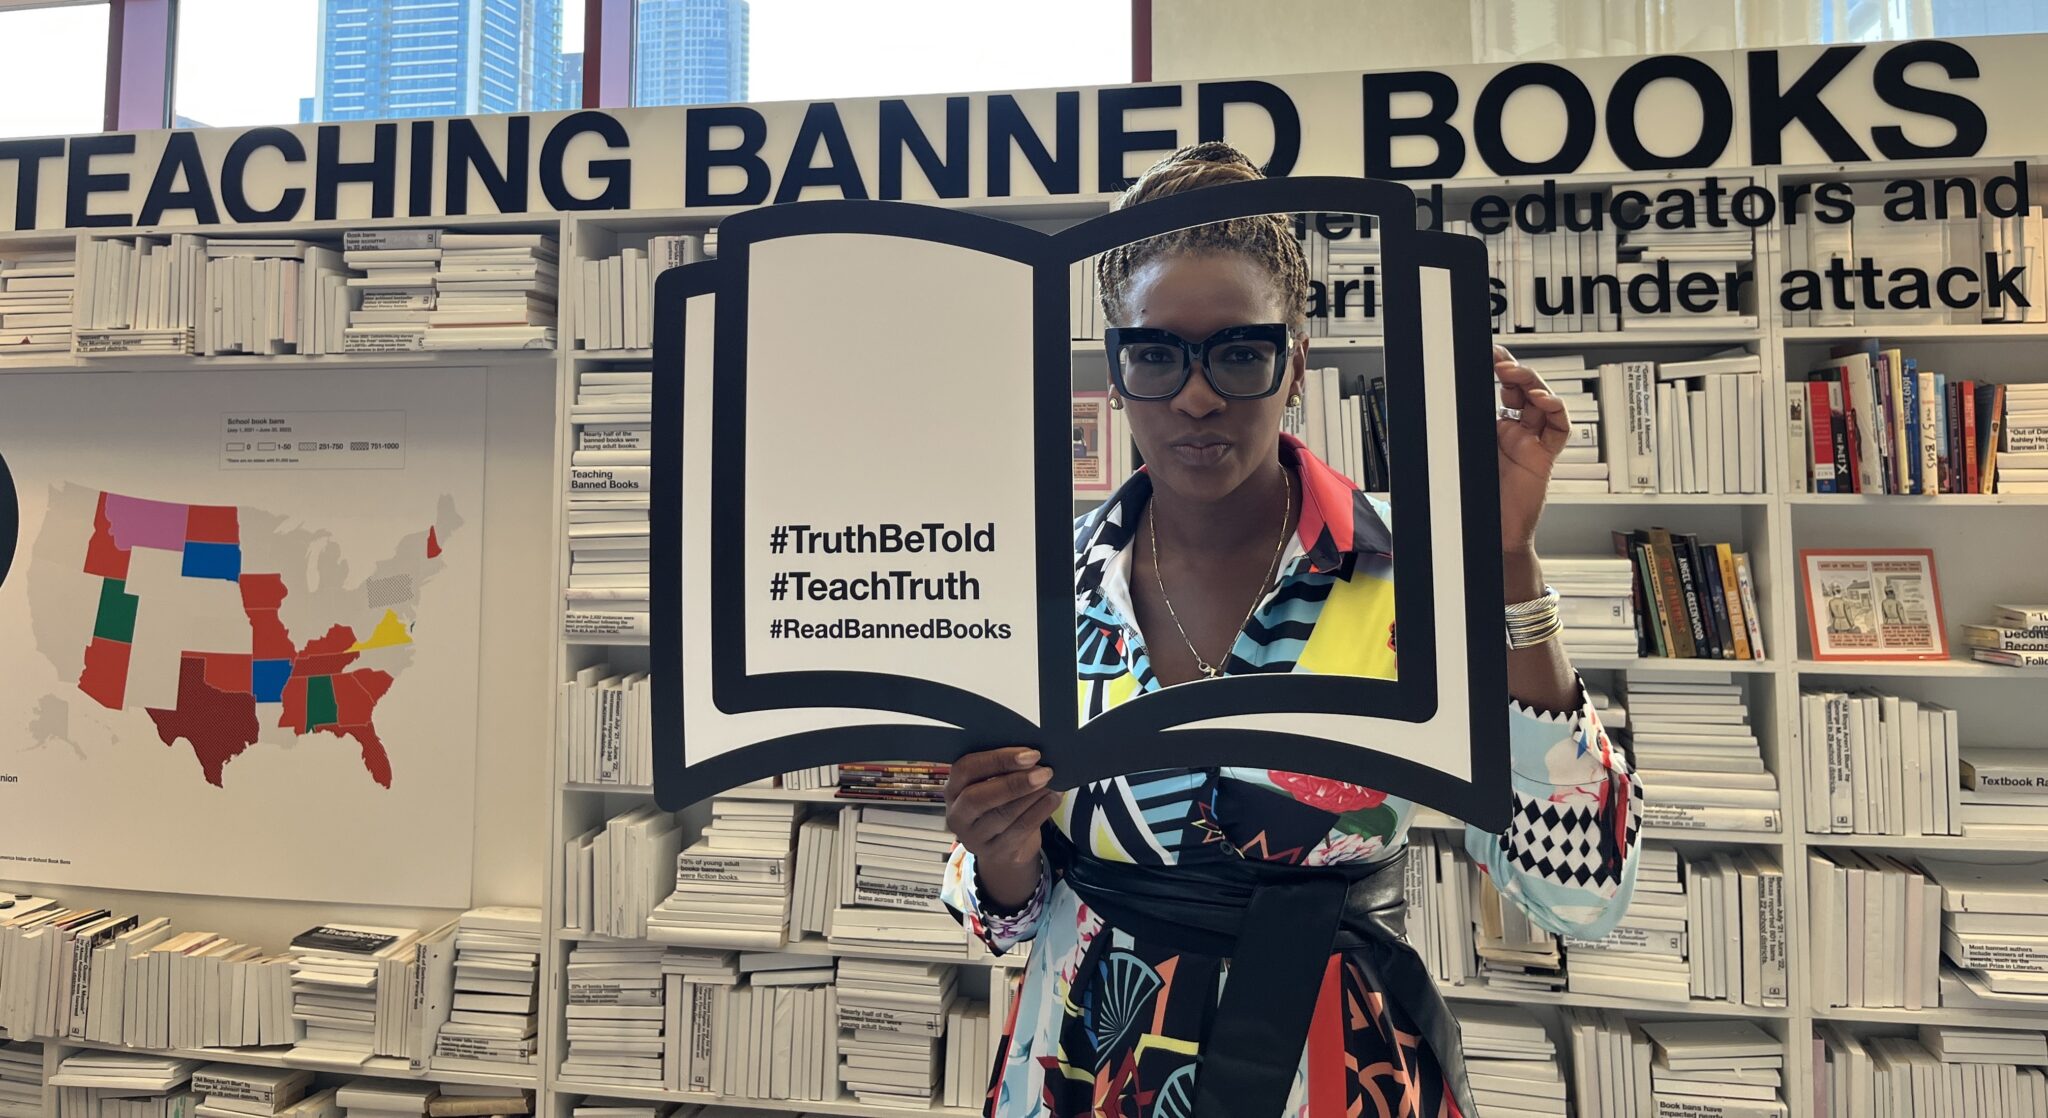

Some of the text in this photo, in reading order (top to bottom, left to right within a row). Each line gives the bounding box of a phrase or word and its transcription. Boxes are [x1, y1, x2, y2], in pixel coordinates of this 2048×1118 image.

[0, 39, 1988, 231] TEACHING BANNED BOOKS
[1469, 176, 1856, 236] educators
[1883, 160, 2030, 221] and
[1534, 258, 1754, 317] under
[1779, 250, 2032, 312] attack
[1634, 366, 1641, 374] by
[1902, 376, 1912, 398] 1619
[2010, 436, 2034, 444] Ashley
[2010, 444, 2036, 452] banned
[571, 470, 613, 480] Teaching
[1837, 463, 1849, 475] X
[571, 480, 640, 489] Banned Books
[770, 522, 995, 554] #TruthBeTold
[770, 571, 981, 601] #TeachTruth
[1678, 557, 1692, 584] ANGEL
[1686, 592, 1705, 641] GREENWOOD
[770, 618, 1012, 639] #ReadBannedBooks
[614, 718, 622, 730] July
[1981, 776, 2033, 786] Textbook
[680, 858, 695, 866] 75%
[887, 883, 899, 891] July
[1768, 898, 1777, 928] reported
[1776, 908, 1784, 922] July
[1760, 910, 1768, 934] school
[840, 1008, 861, 1017] Nearly
[840, 1022, 860, 1030] young
[1659, 1101, 1723, 1113] Book bans have
[1659, 1109, 1697, 1118] impacted
